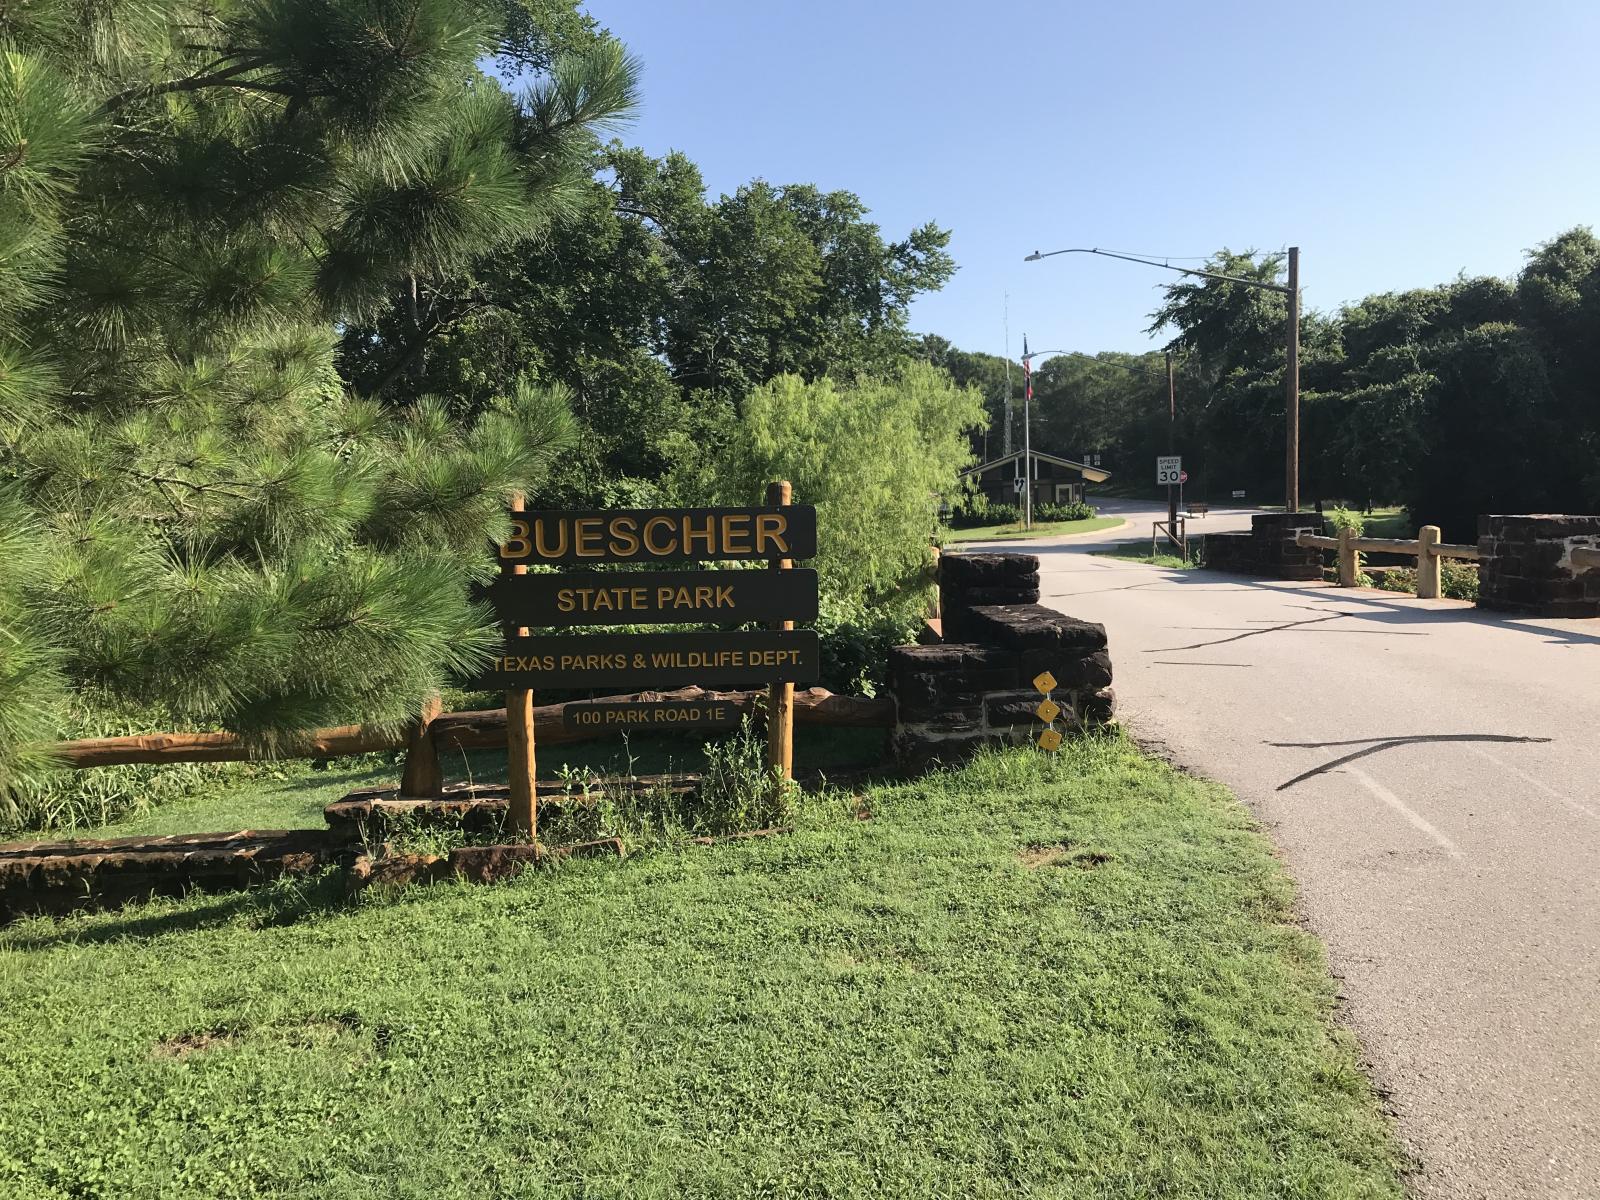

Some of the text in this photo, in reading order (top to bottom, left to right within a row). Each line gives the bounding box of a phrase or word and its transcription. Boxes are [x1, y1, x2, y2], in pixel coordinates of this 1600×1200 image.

[1160, 471, 1178, 481] 30
[500, 514, 789, 558] BUESCHER
[557, 585, 735, 612] STATE PARK
[494, 650, 803, 672] TEXAS PARKS & WILDLIFE DEPT.
[573, 707, 726, 724] 100 PARK ROAD 1E
